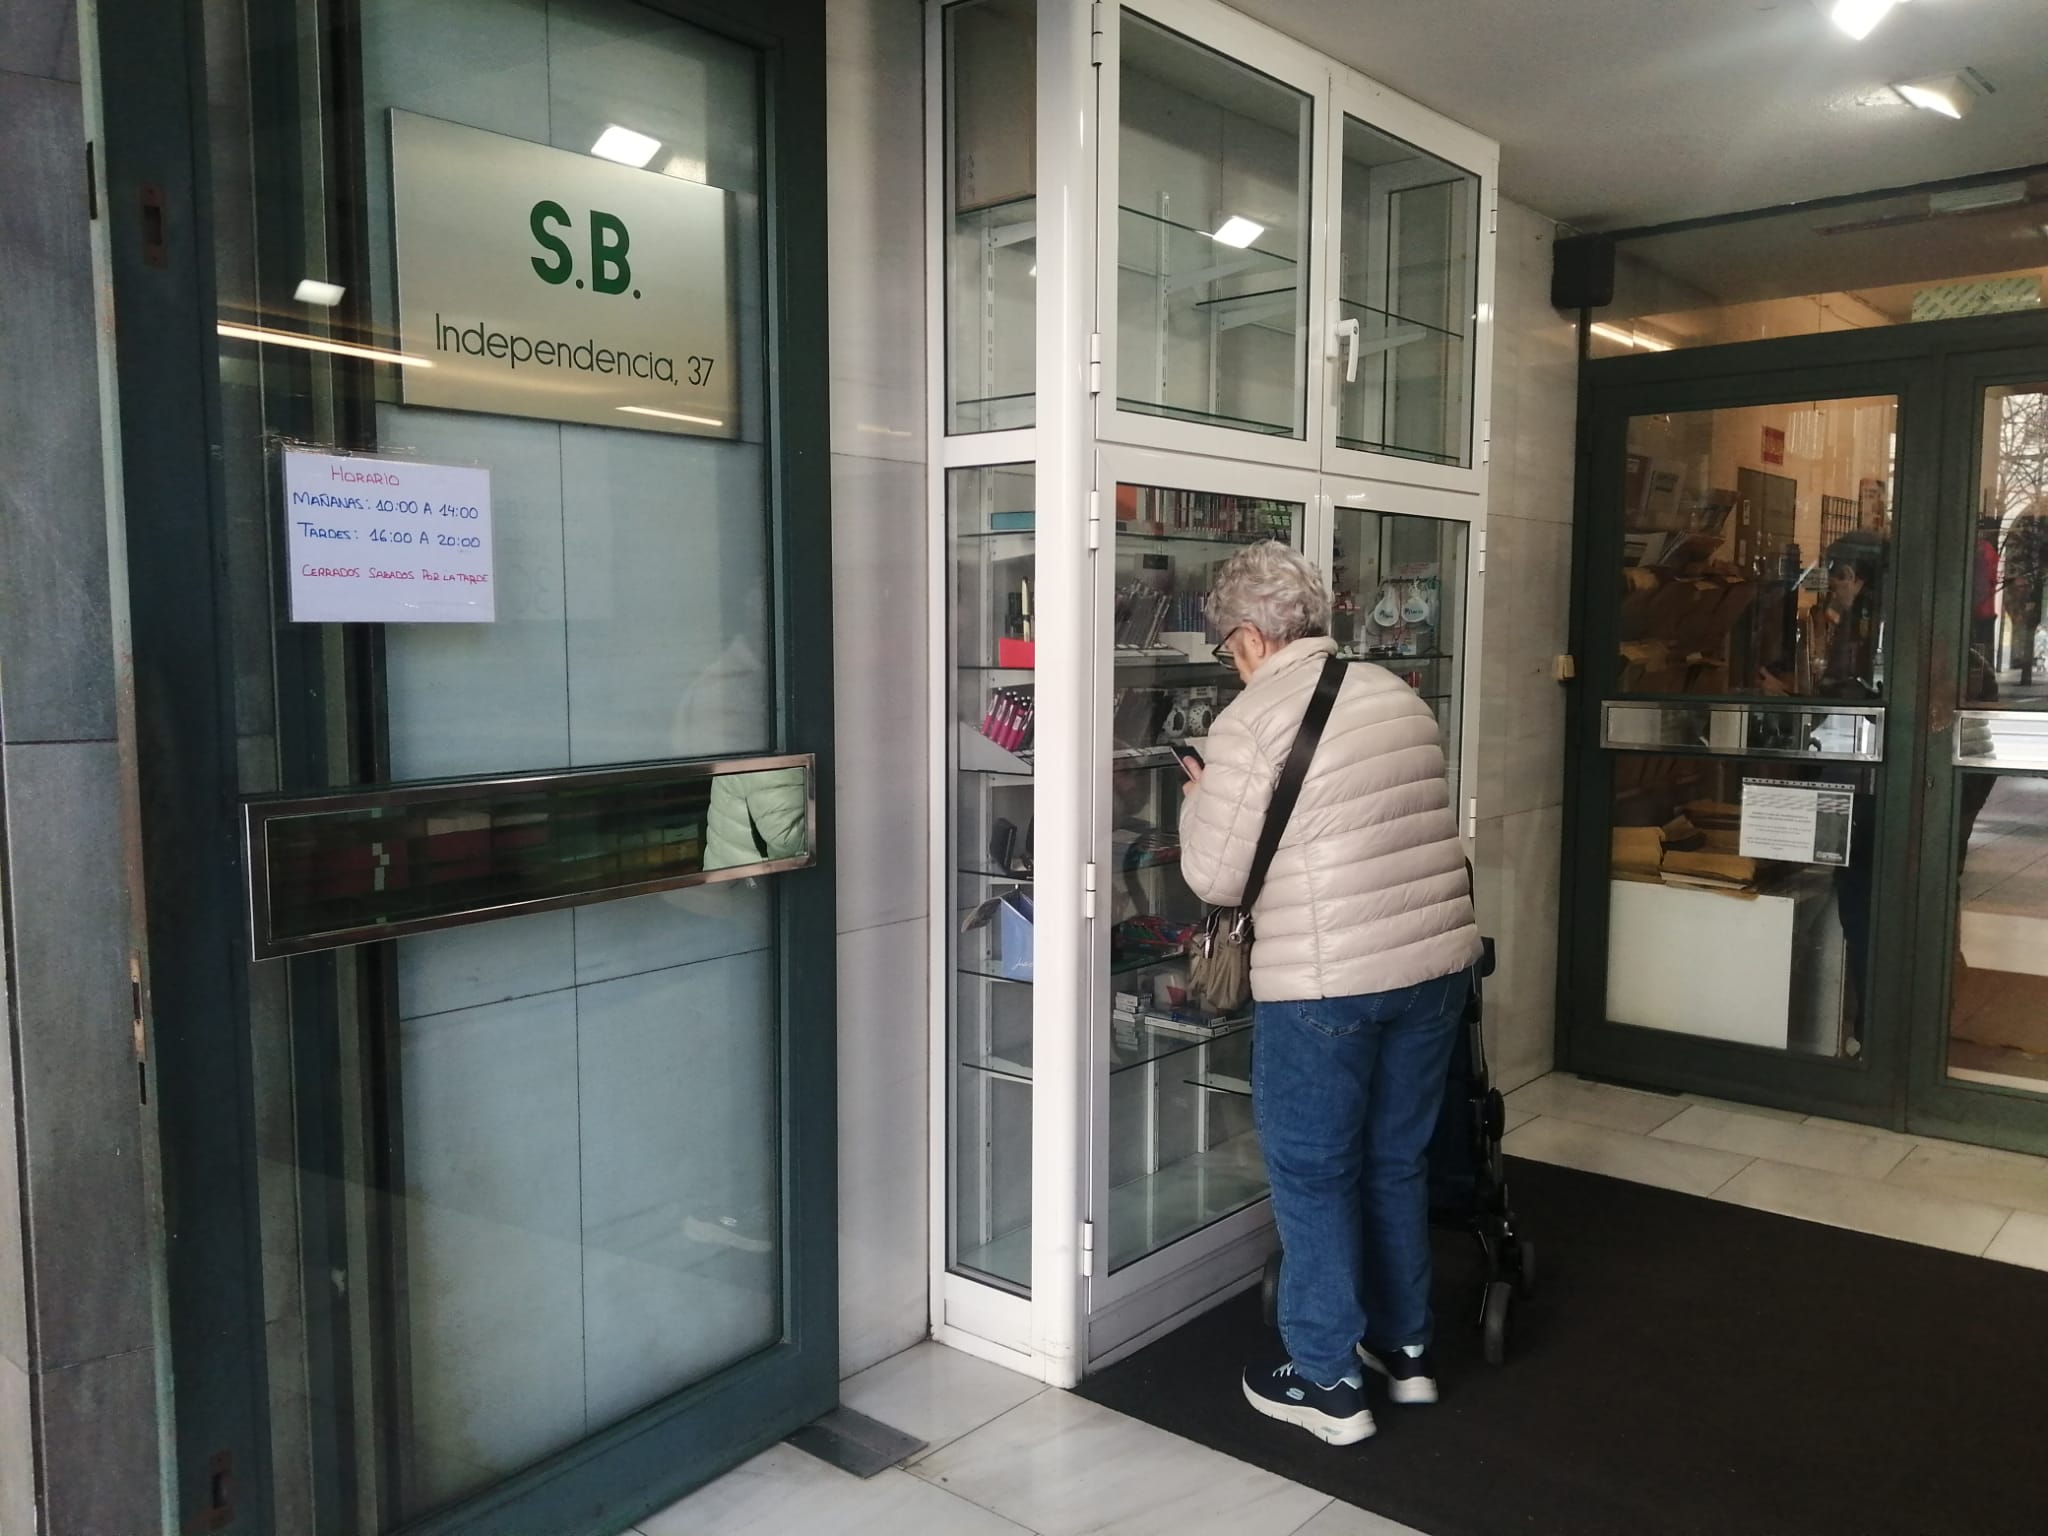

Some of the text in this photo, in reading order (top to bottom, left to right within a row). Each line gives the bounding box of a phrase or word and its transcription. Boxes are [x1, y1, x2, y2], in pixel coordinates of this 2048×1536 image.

[530, 200, 641, 299] S.B.
[435, 313, 714, 387] Independencia, 37
[331, 465, 400, 486] HORARIO
[293, 491, 479, 519] MAÑANAS: 10:00 A 14:00
[297, 522, 480, 548] TARDES: 16:00 A 20:00
[302, 564, 361, 578] CERRADOS
[368, 567, 415, 580] SABADOS
[422, 569, 440, 582] POR
